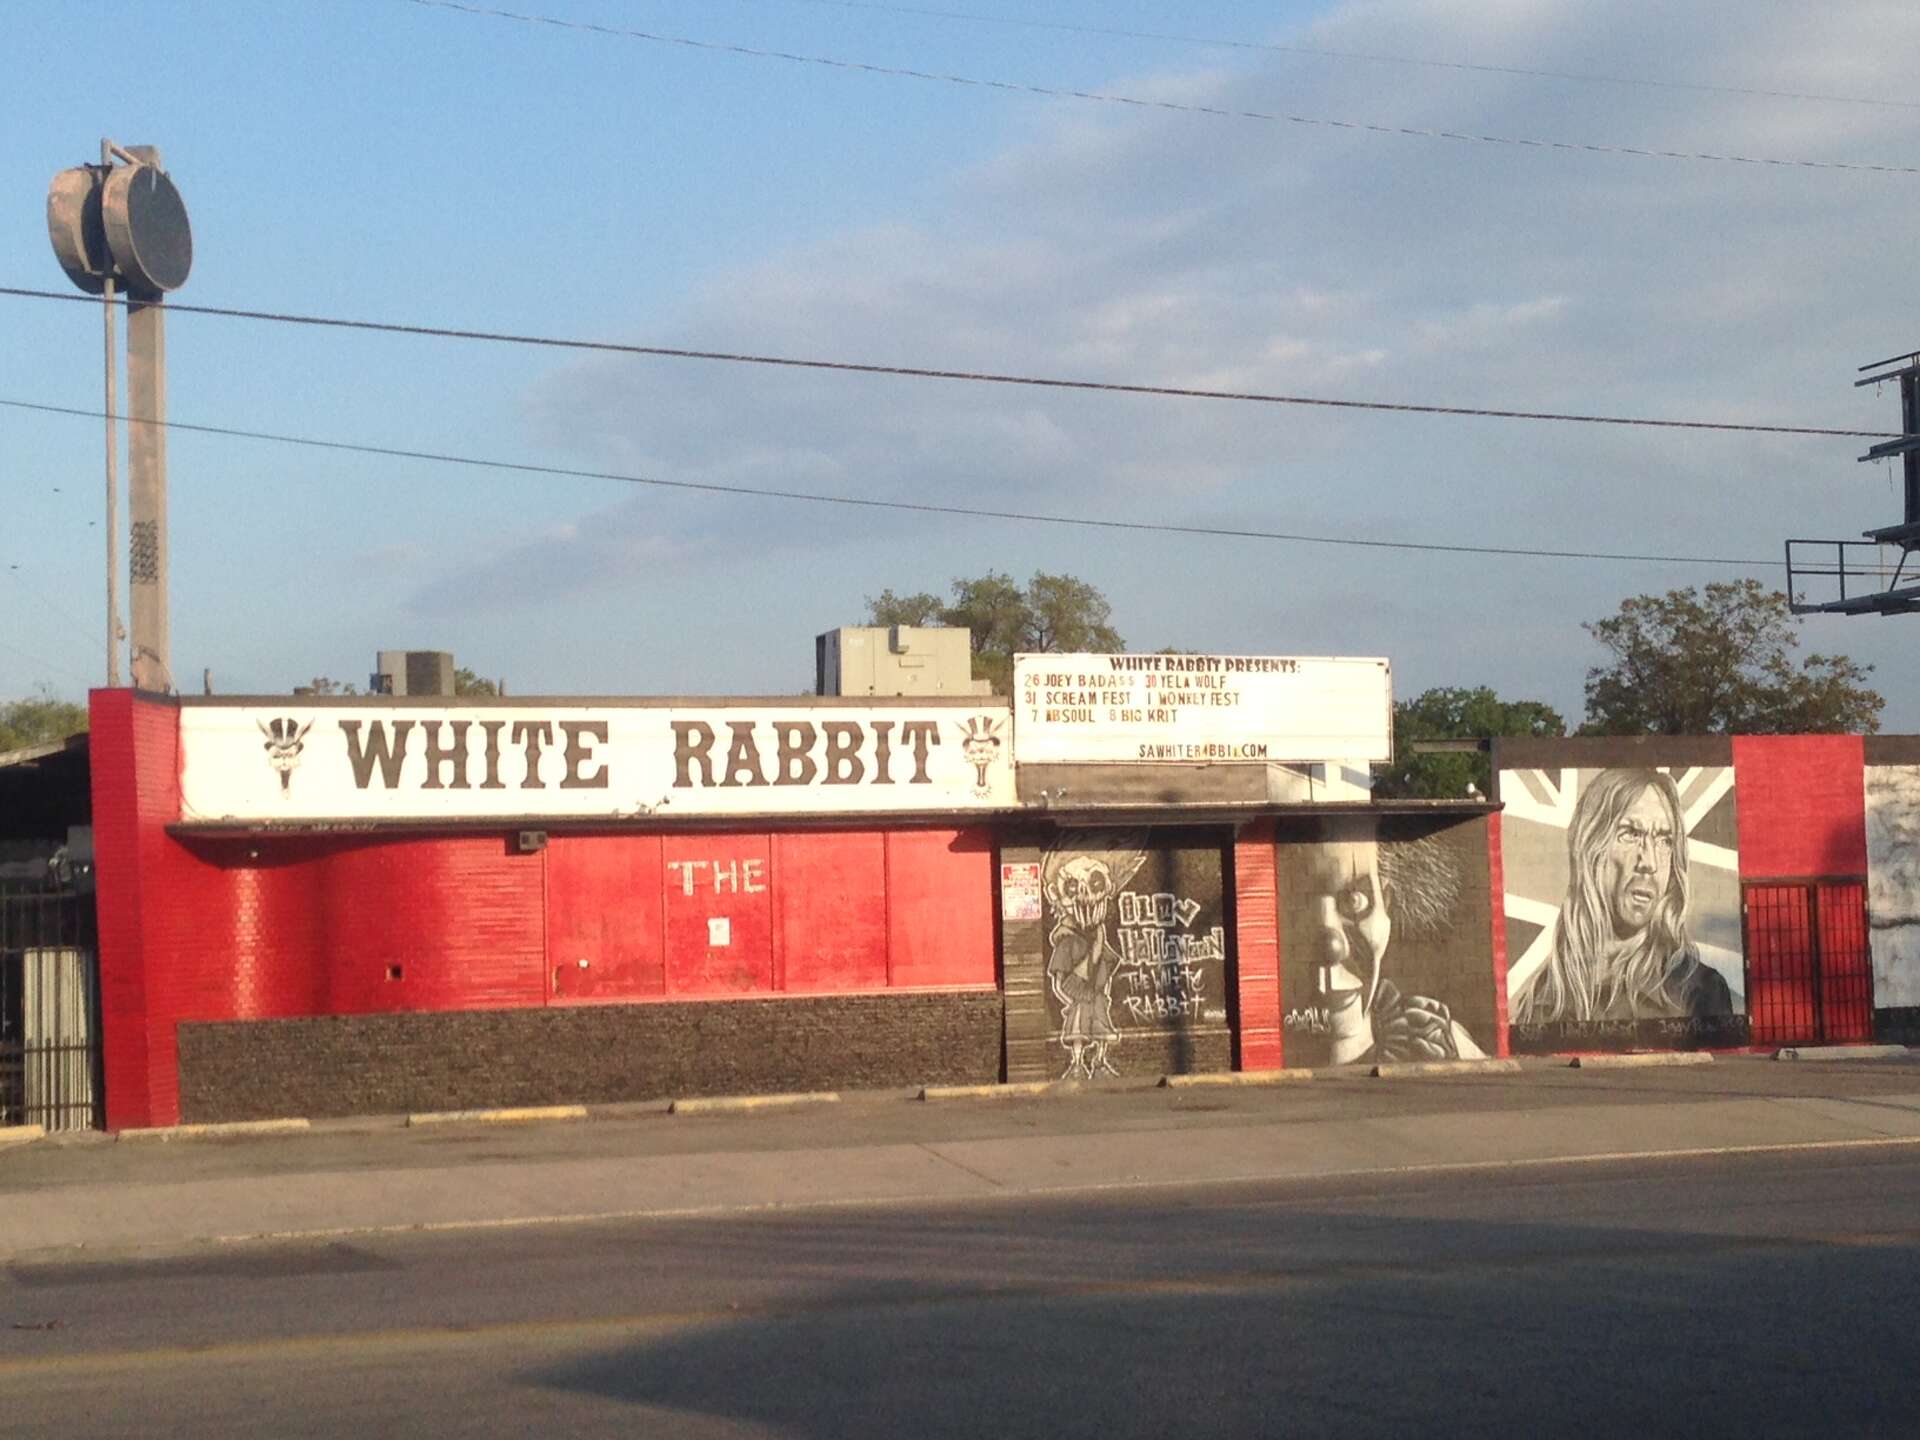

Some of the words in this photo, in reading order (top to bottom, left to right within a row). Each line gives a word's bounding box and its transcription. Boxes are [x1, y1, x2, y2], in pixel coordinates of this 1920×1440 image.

[1109, 657, 1161, 672] WHITE
[1165, 657, 1220, 672] RABBIT
[1225, 659, 1301, 674] PRESENTS:
[1024, 674, 1040, 688] 26
[1044, 674, 1072, 687] JOEY
[1145, 675, 1157, 688] 30
[1161, 675, 1190, 689] YELA
[1195, 675, 1227, 689] WOLF
[1025, 691, 1036, 705] 31
[1046, 691, 1097, 705] SCREAM
[1102, 691, 1131, 705] FEST
[1211, 692, 1240, 706] FEST
[1032, 709, 1038, 722] 7
[1109, 709, 1117, 721] 8
[1121, 709, 1142, 722] BIG
[1147, 709, 1178, 722] KRIT
[338, 720, 609, 789] WHITE
[671, 721, 941, 788] RABBIT
[667, 859, 766, 896] THE
